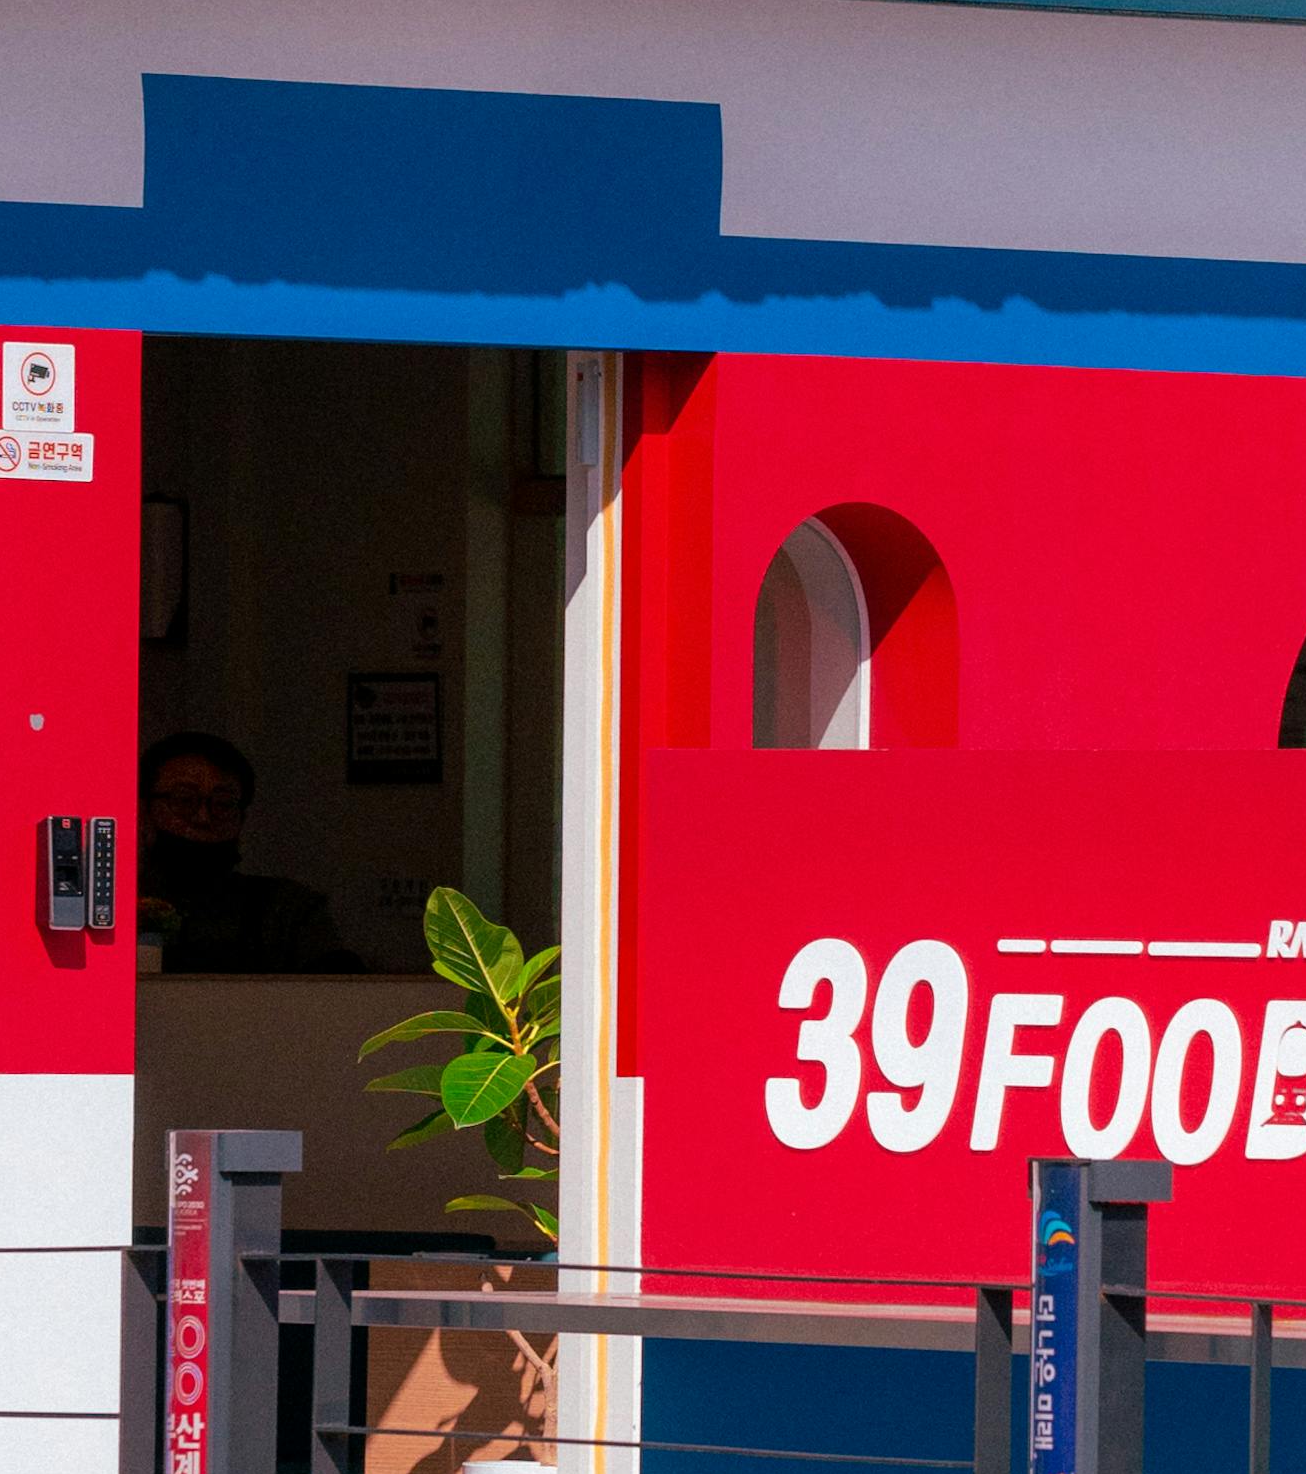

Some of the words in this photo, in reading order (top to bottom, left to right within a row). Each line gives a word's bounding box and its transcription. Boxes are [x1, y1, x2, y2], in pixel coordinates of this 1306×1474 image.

[12, 401, 37, 412] CCTV
[28, 441, 83, 462] 금연구역
[1035, 1294, 1056, 1321] 더
[1035, 1329, 1056, 1387] 나은
